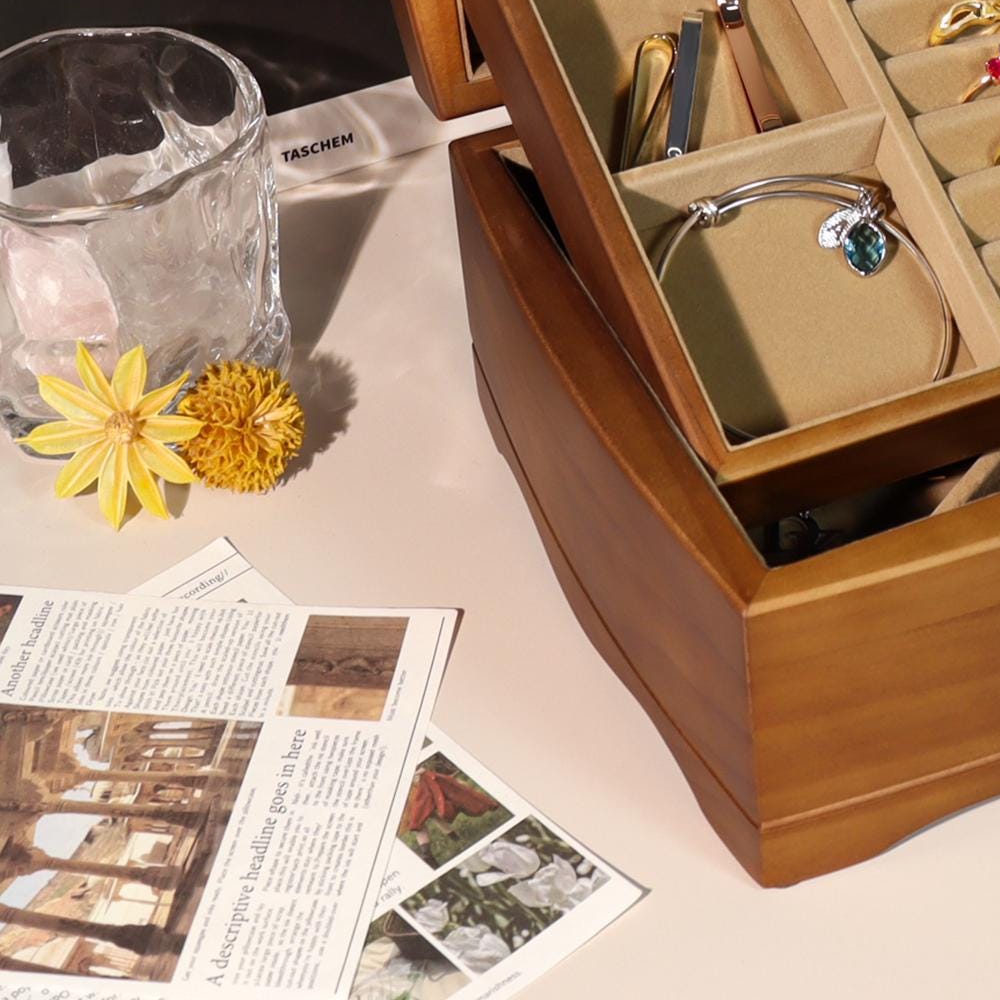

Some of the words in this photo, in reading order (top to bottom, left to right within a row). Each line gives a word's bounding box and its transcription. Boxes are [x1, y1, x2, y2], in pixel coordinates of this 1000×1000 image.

[1, 650, 32, 697] Another
[281, 729, 306, 759] here
[276, 764, 295, 777] in
[269, 782, 289, 814] goes
[243, 818, 277, 880] headline
[211, 885, 254, 969] descriptive
[206, 974, 224, 986] A
